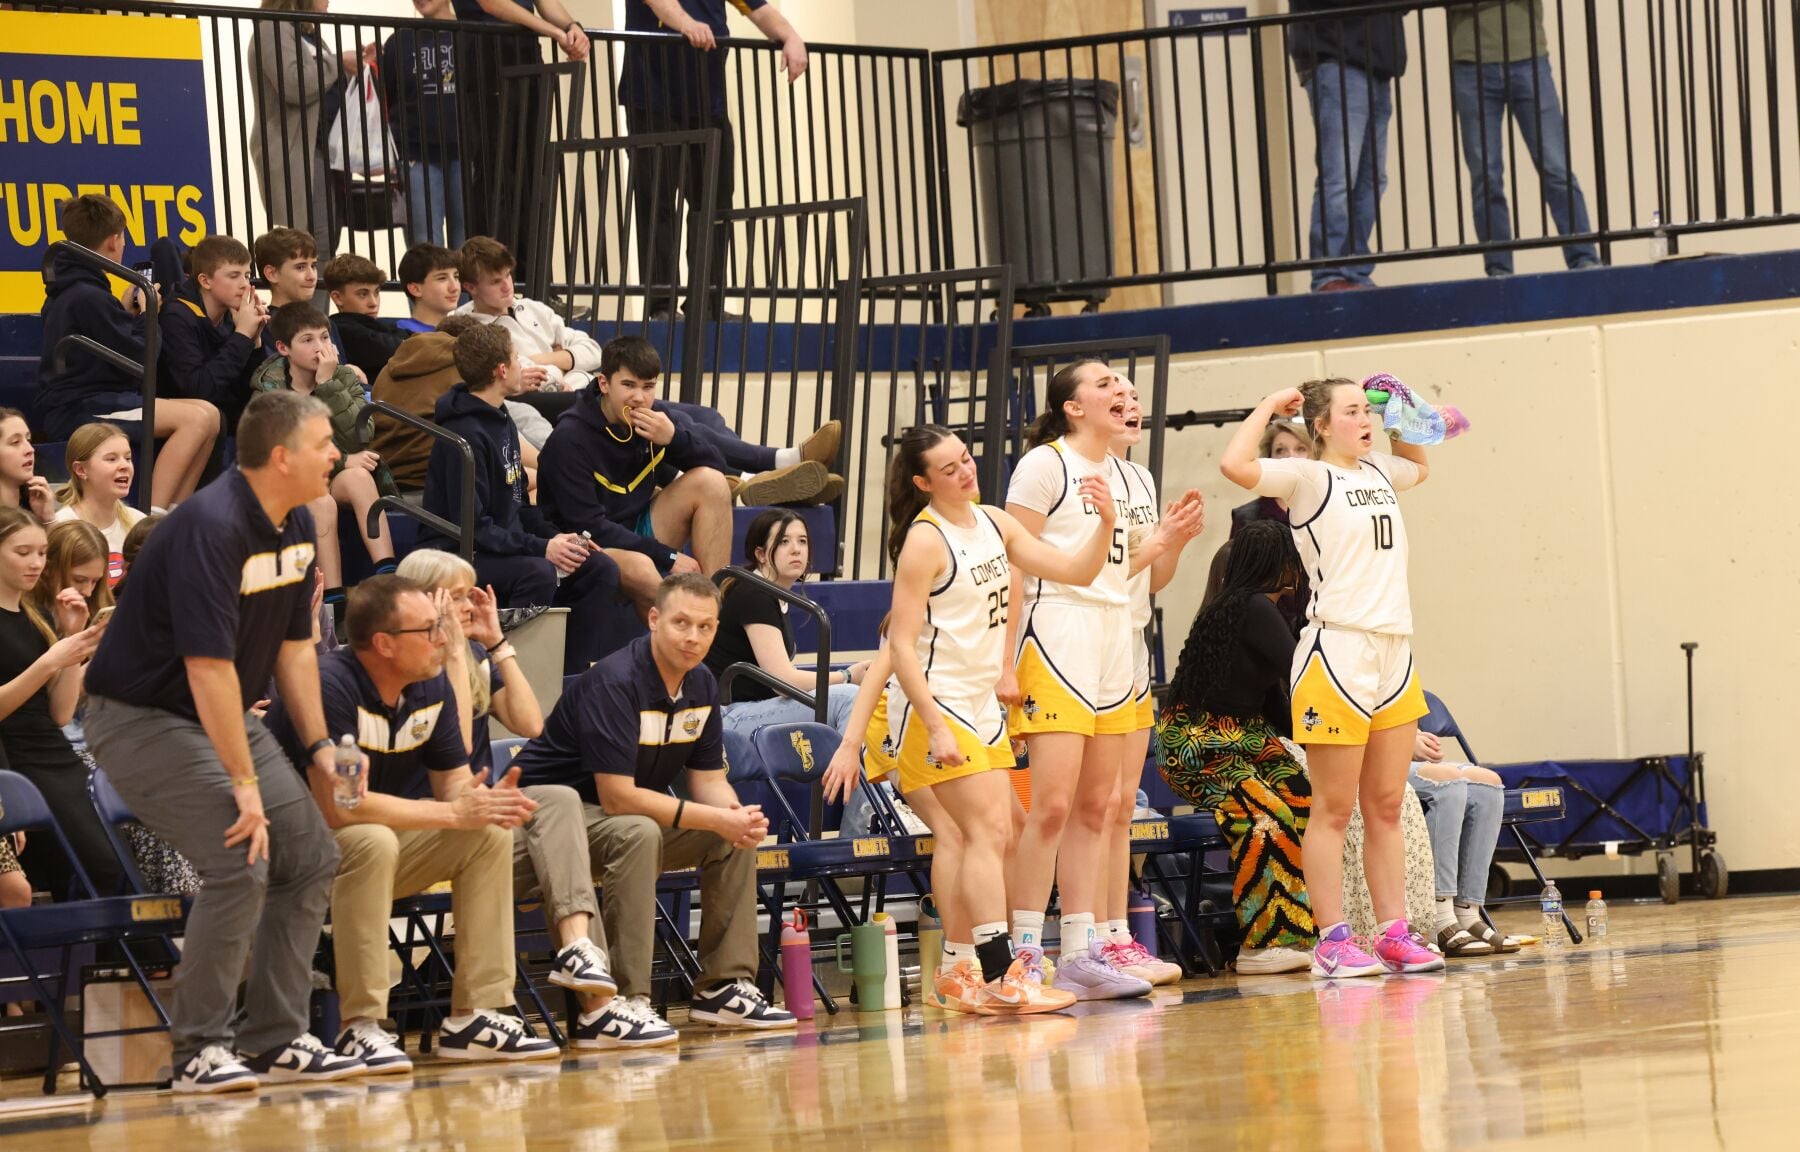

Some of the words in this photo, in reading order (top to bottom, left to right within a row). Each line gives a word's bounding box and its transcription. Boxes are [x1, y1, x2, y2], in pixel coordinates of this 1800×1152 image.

[0, 79, 141, 145] HOME
[1345, 488, 1396, 507] COMETS
[1371, 514, 1393, 551] 10
[988, 585, 1009, 629] 25
[1521, 789, 1561, 808] COMETS
[853, 837, 890, 858] COMETS
[1588, 917, 1597, 927] G
